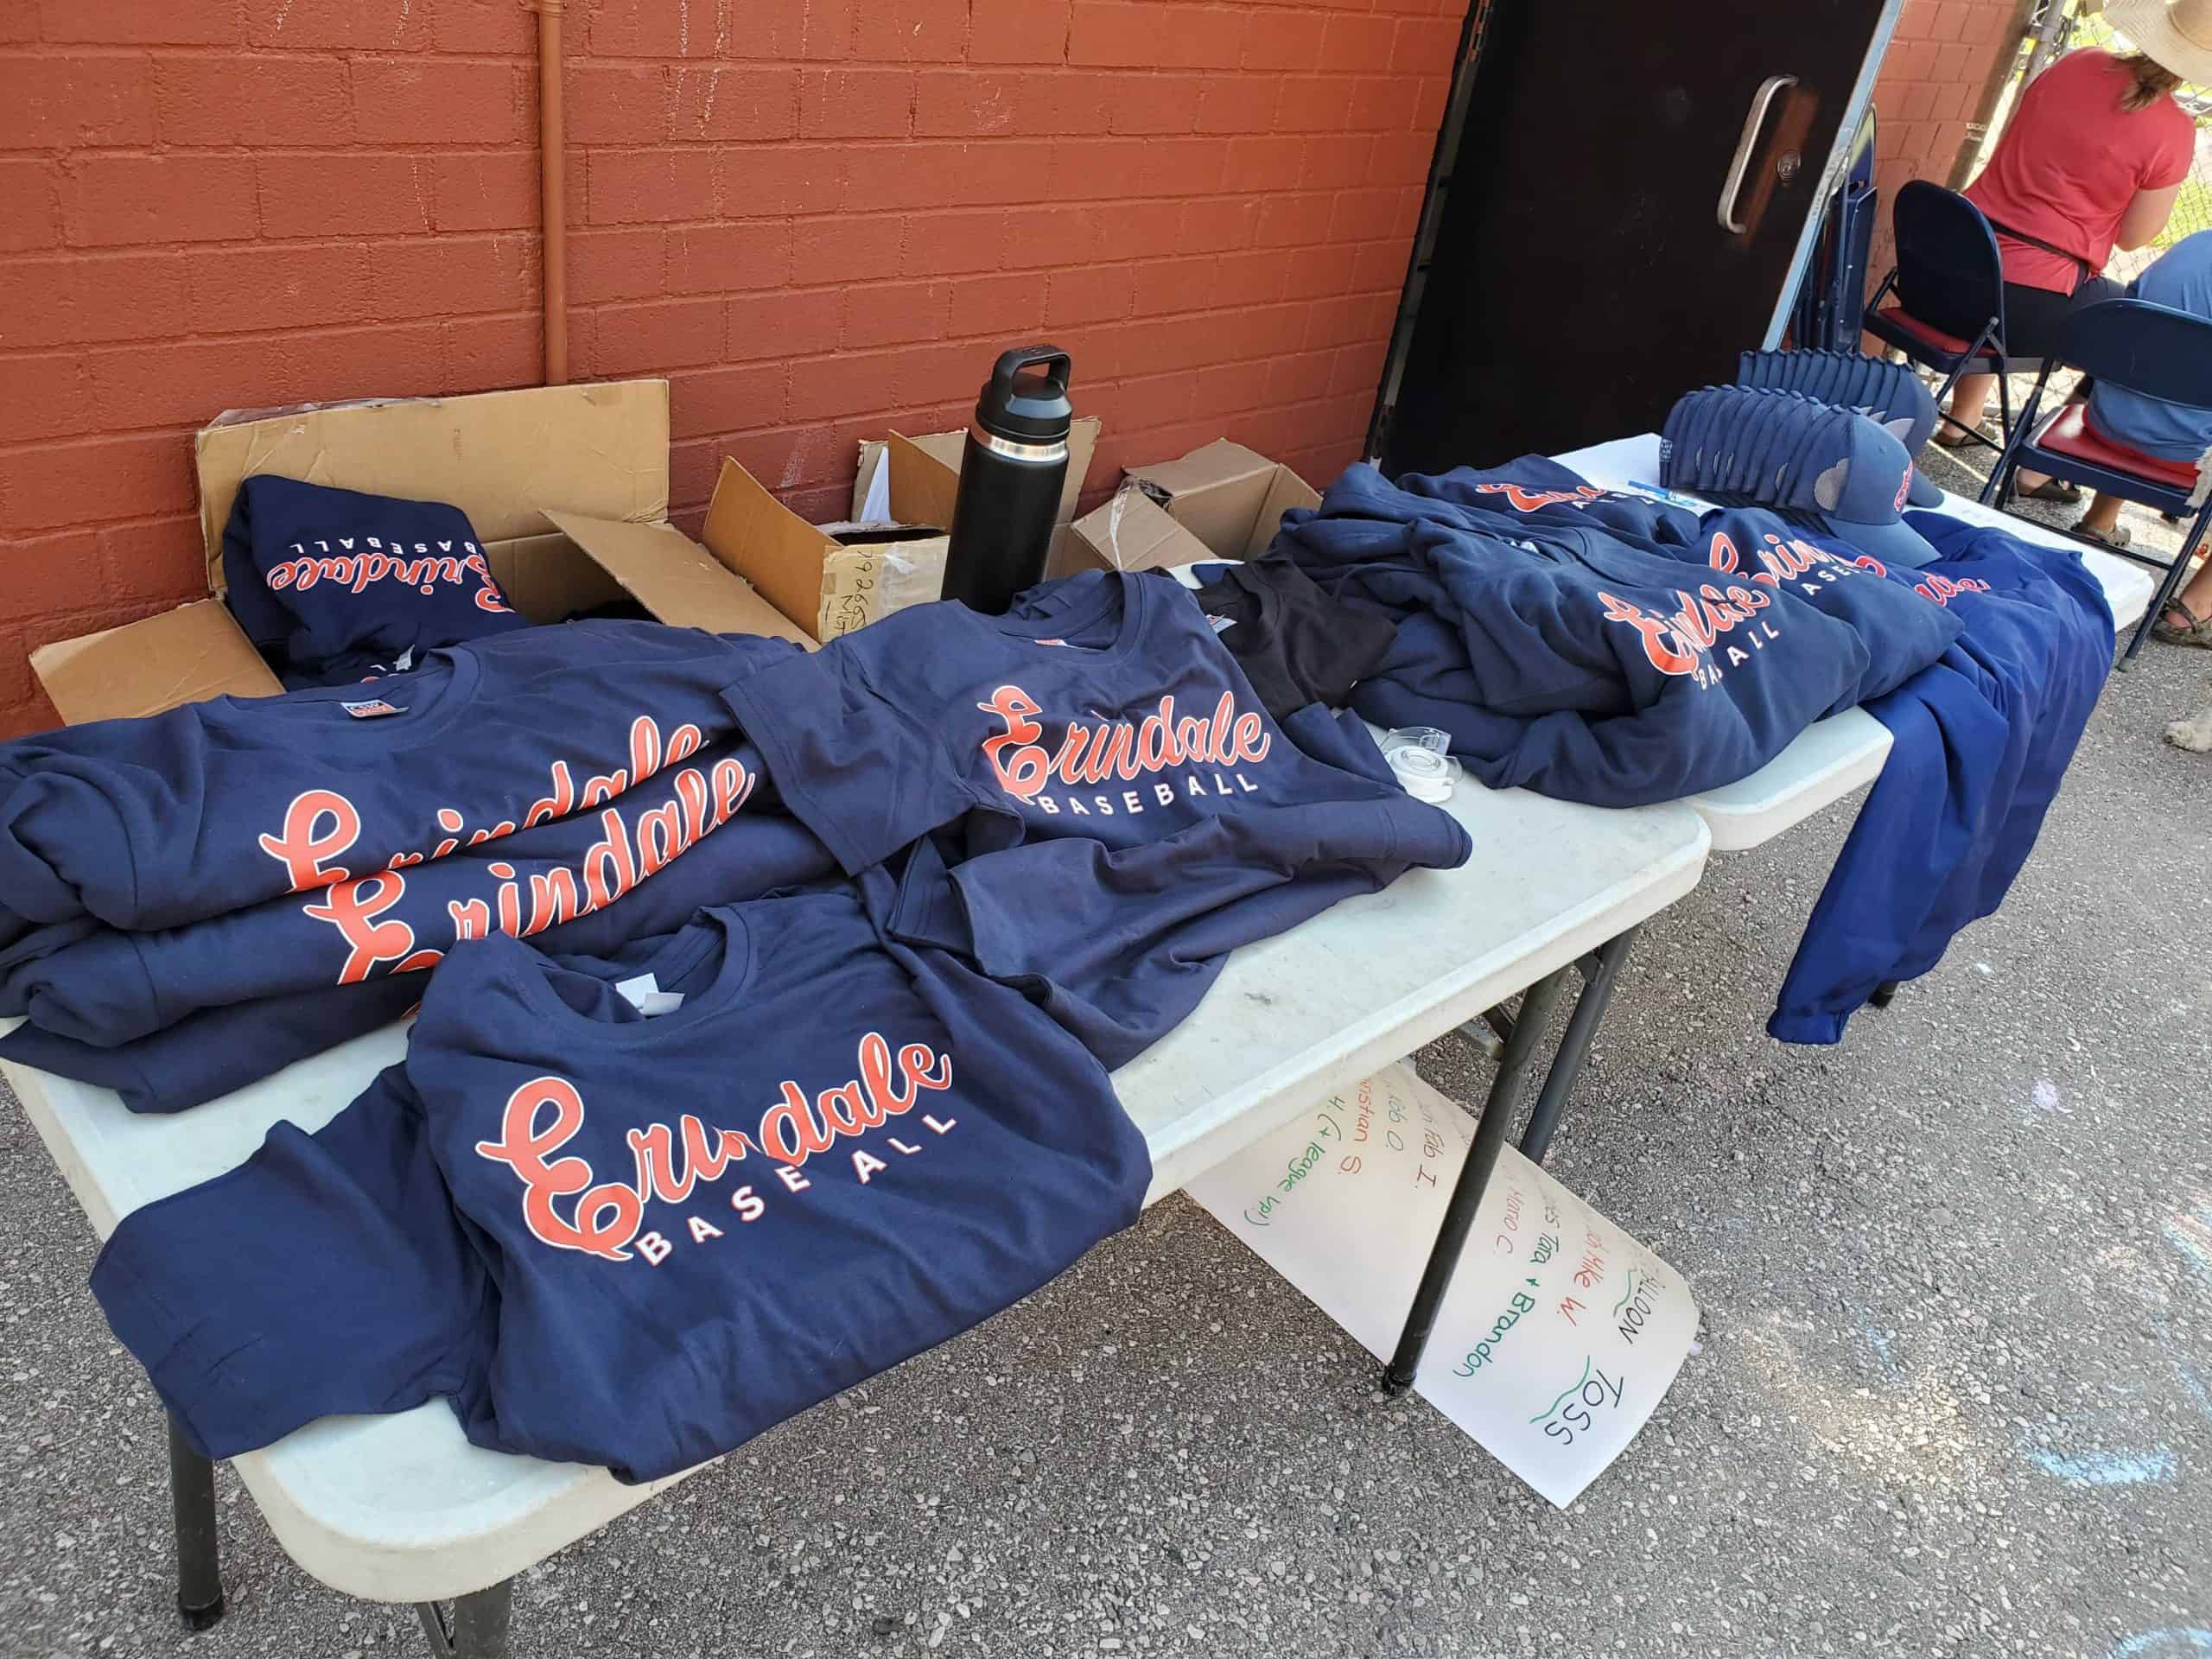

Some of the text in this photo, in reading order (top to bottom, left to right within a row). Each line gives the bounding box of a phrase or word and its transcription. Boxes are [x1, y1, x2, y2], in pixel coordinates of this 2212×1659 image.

[289, 537, 476, 555] BASEBALL
[266, 552, 518, 613] Erindale
[977, 685, 1271, 805] Erindale
[1038, 773, 1258, 816] BASEBALL
[634, 1114, 957, 1267] BASEALL
[1277, 1141, 1326, 1192] league
[1529, 1231, 1560, 1264] Tara
[1452, 1291, 1535, 1378] Brandon
[1544, 1369, 1624, 1446] TOSS
